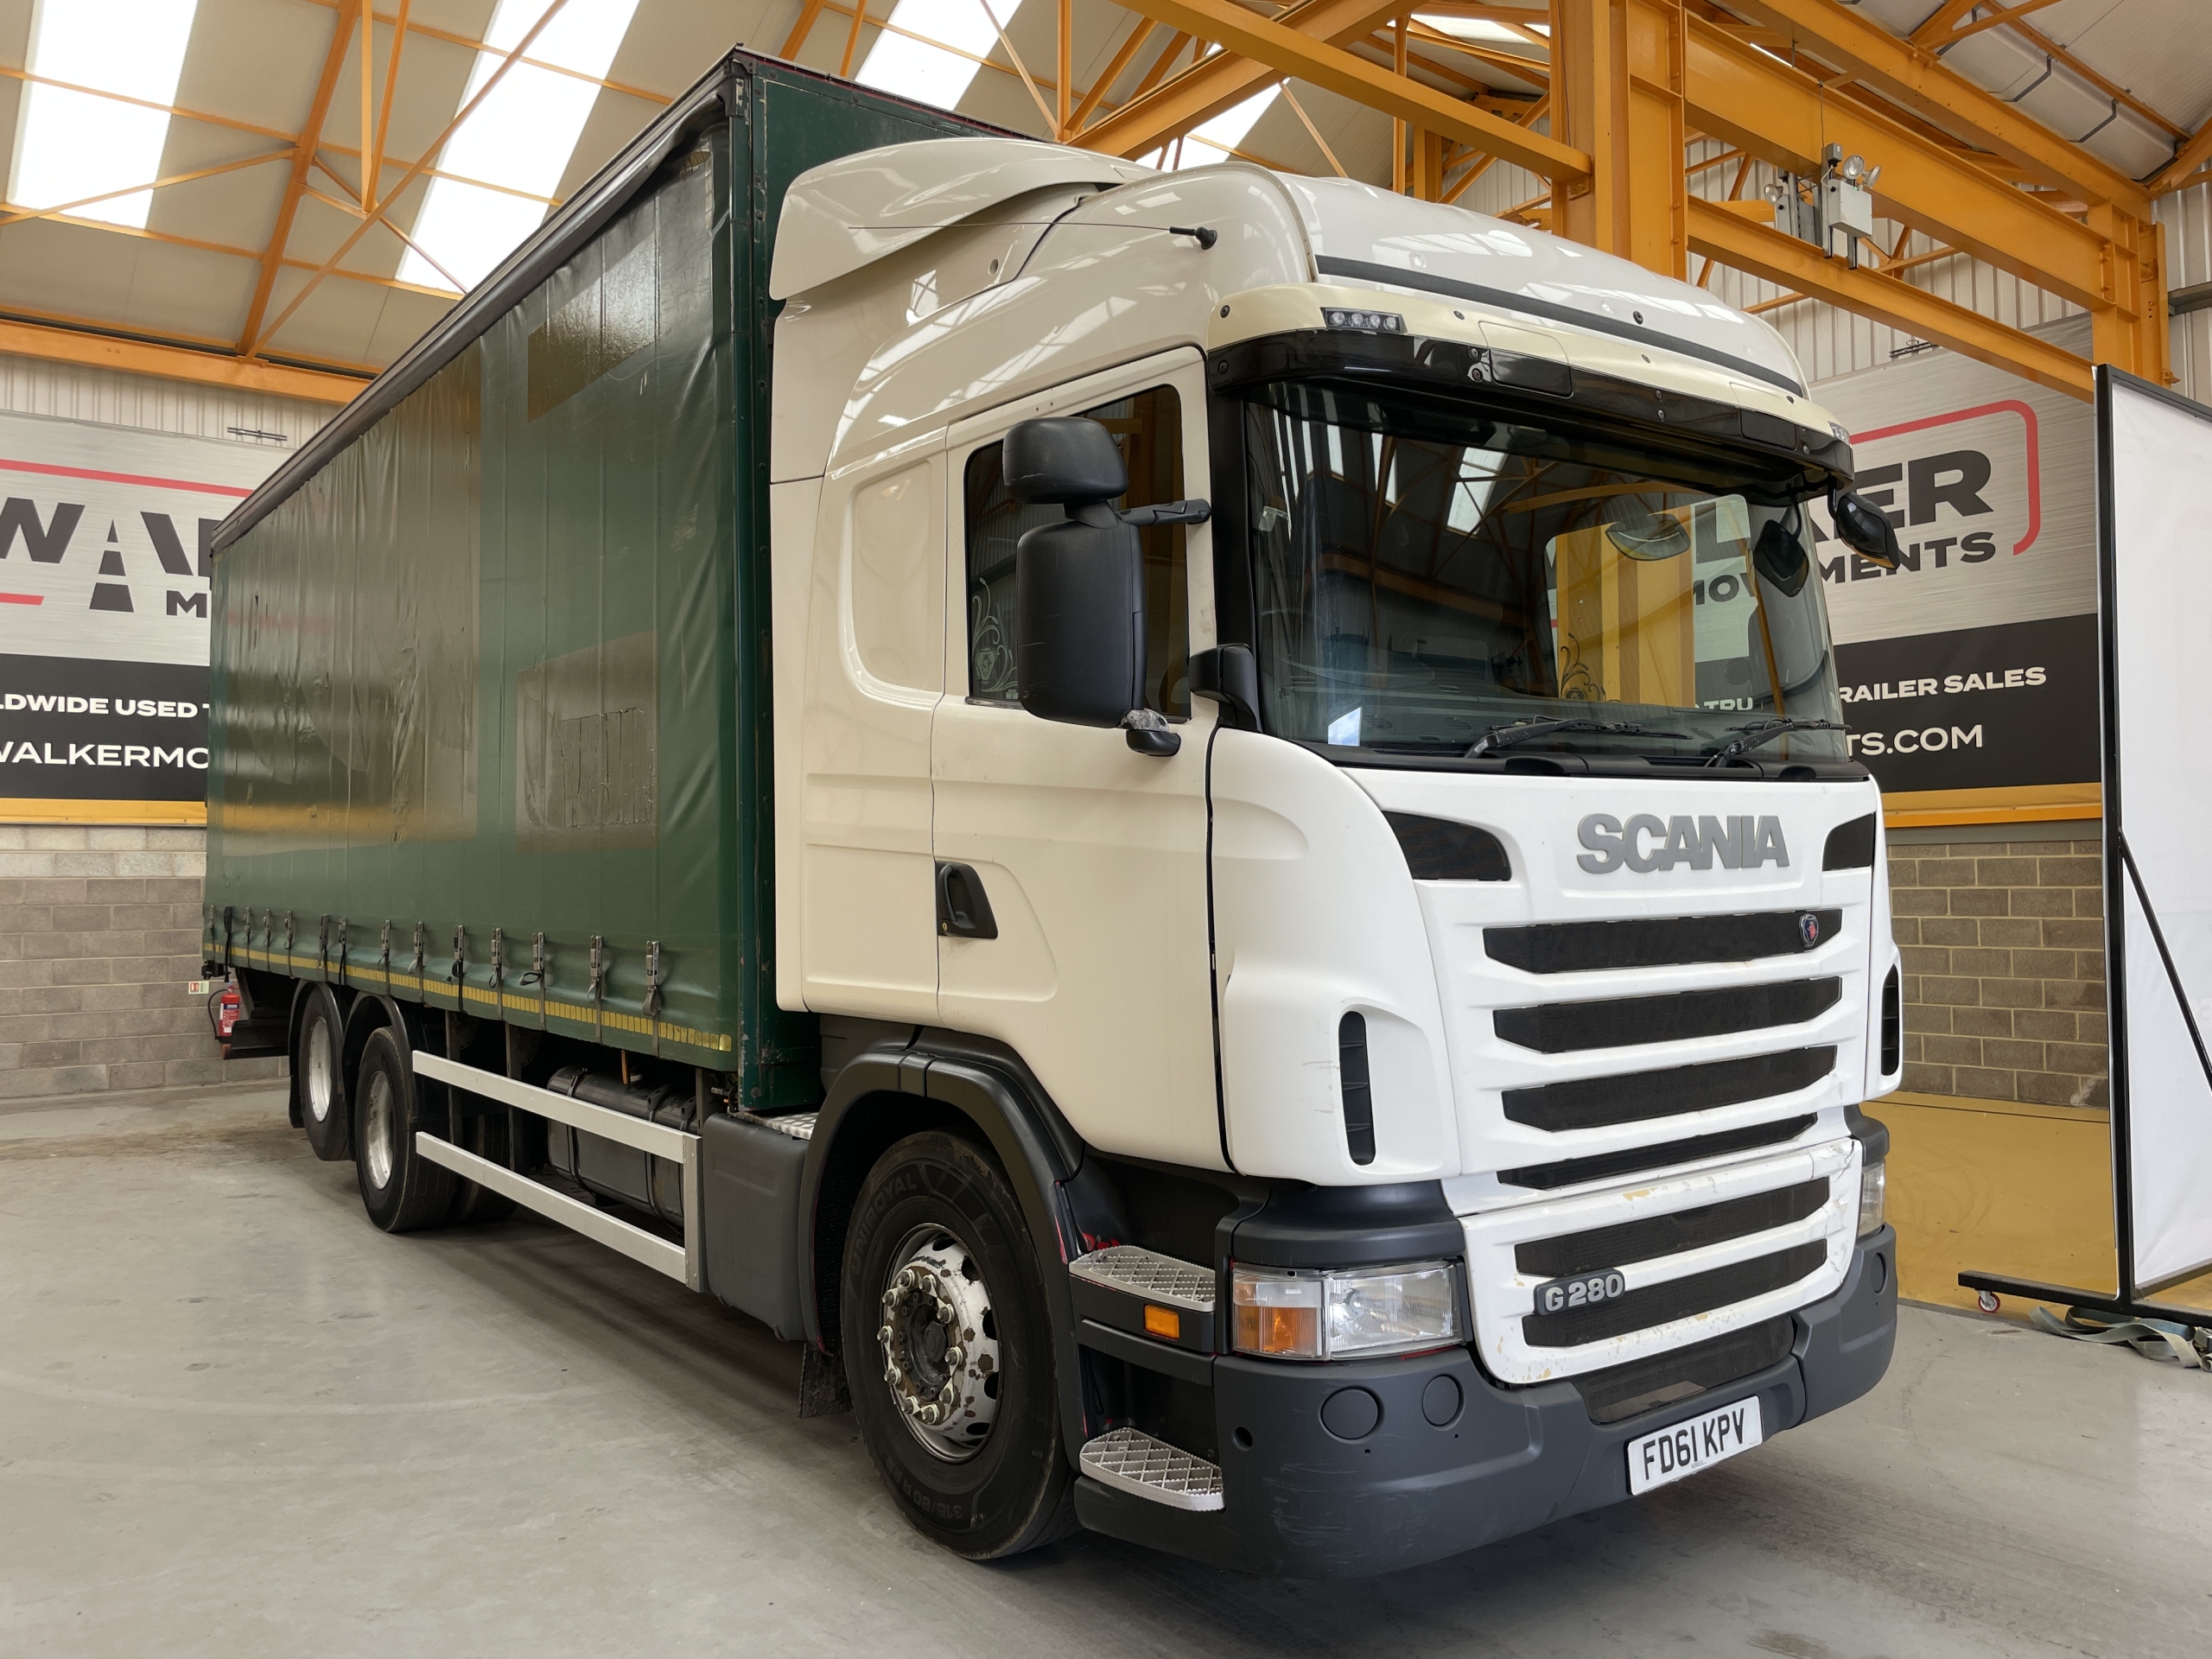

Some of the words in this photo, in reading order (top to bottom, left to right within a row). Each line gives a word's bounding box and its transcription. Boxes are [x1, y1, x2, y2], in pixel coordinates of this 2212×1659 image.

[1839, 677, 1938, 703] RAILER
[1943, 666, 2047, 694] SALES
[0, 693, 110, 715] DWIDE
[115, 698, 199, 719] USED
[1576, 812, 1790, 874] SCANIA
[1545, 1287, 1564, 1312] G
[1567, 1274, 1624, 1308] 280
[1643, 1425, 1699, 1481] FD61
[1702, 1408, 1745, 1459] KPV
